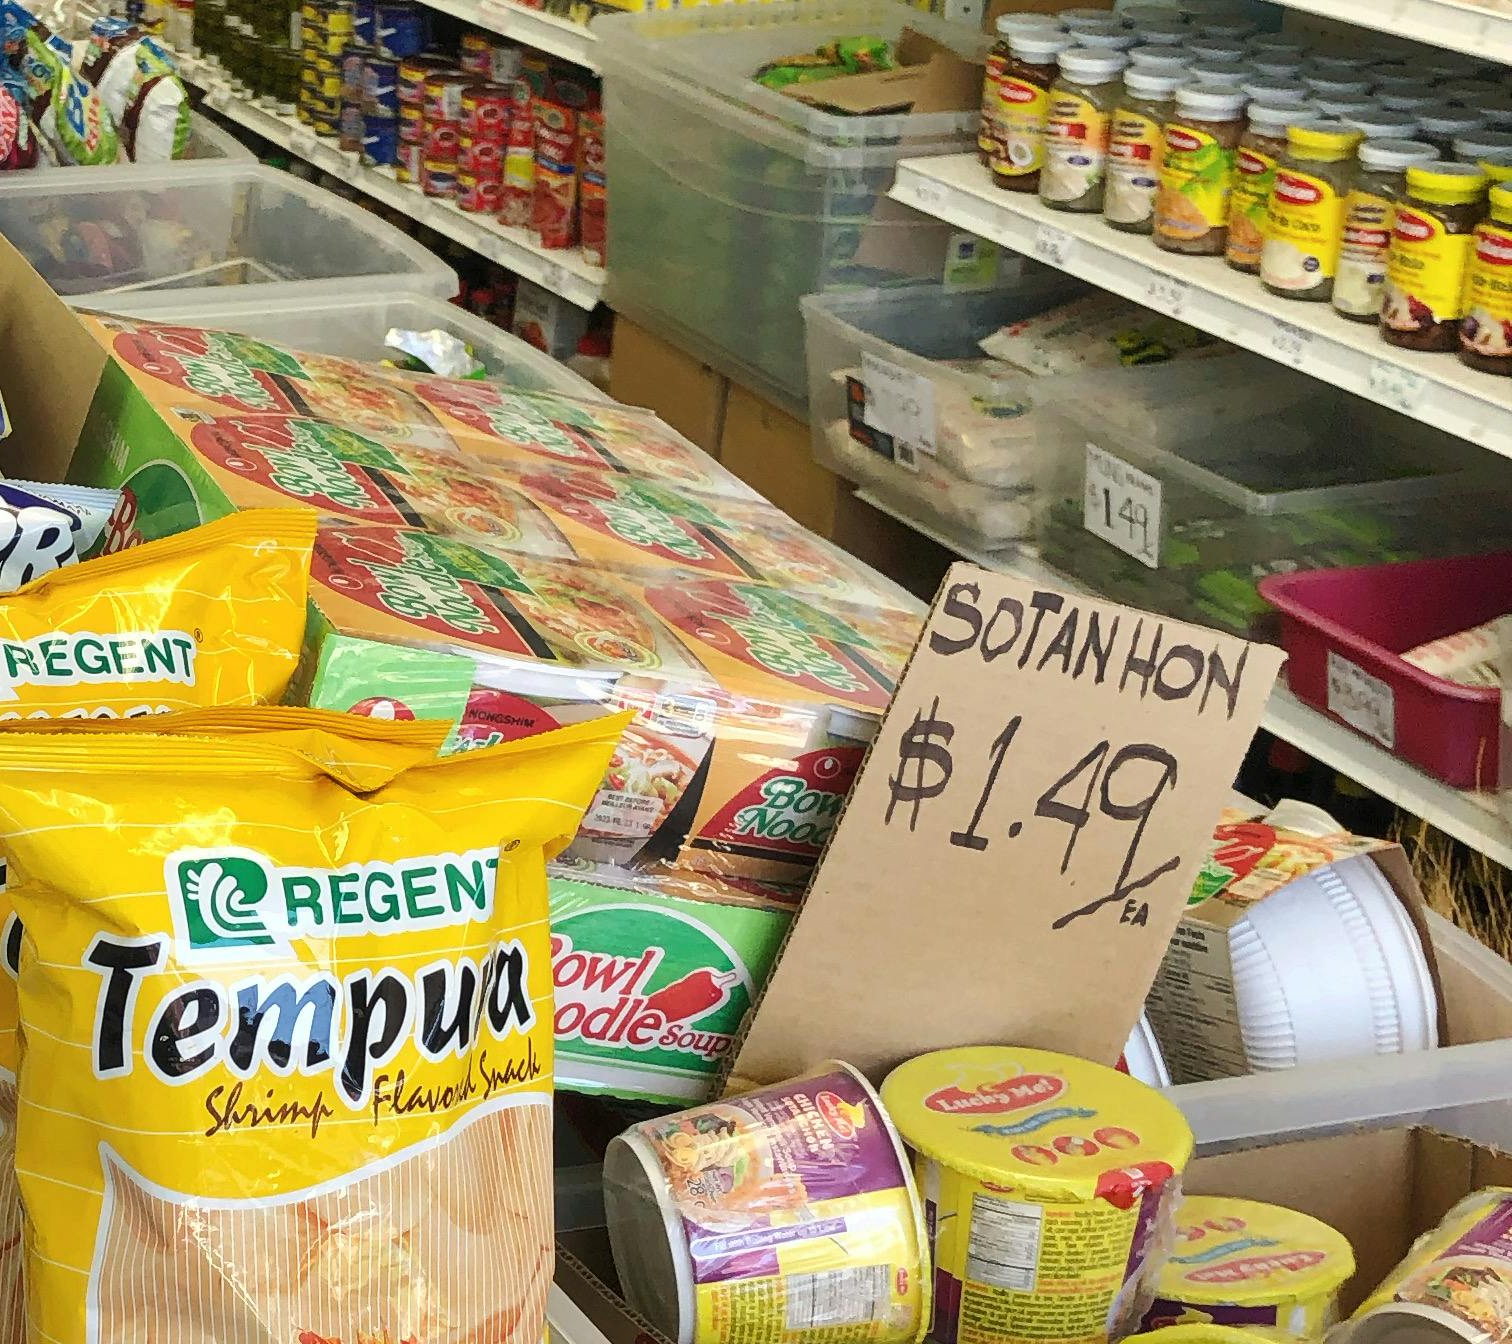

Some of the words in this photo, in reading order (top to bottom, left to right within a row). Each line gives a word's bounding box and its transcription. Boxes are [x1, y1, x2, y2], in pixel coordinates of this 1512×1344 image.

[5, 630, 194, 680] REGENT
[467, 707, 536, 729] NONGSHIM
[762, 776, 843, 814] Bow
[205, 1082, 334, 1138] Shrimp
[936, 1086, 1012, 1113] Lucky
